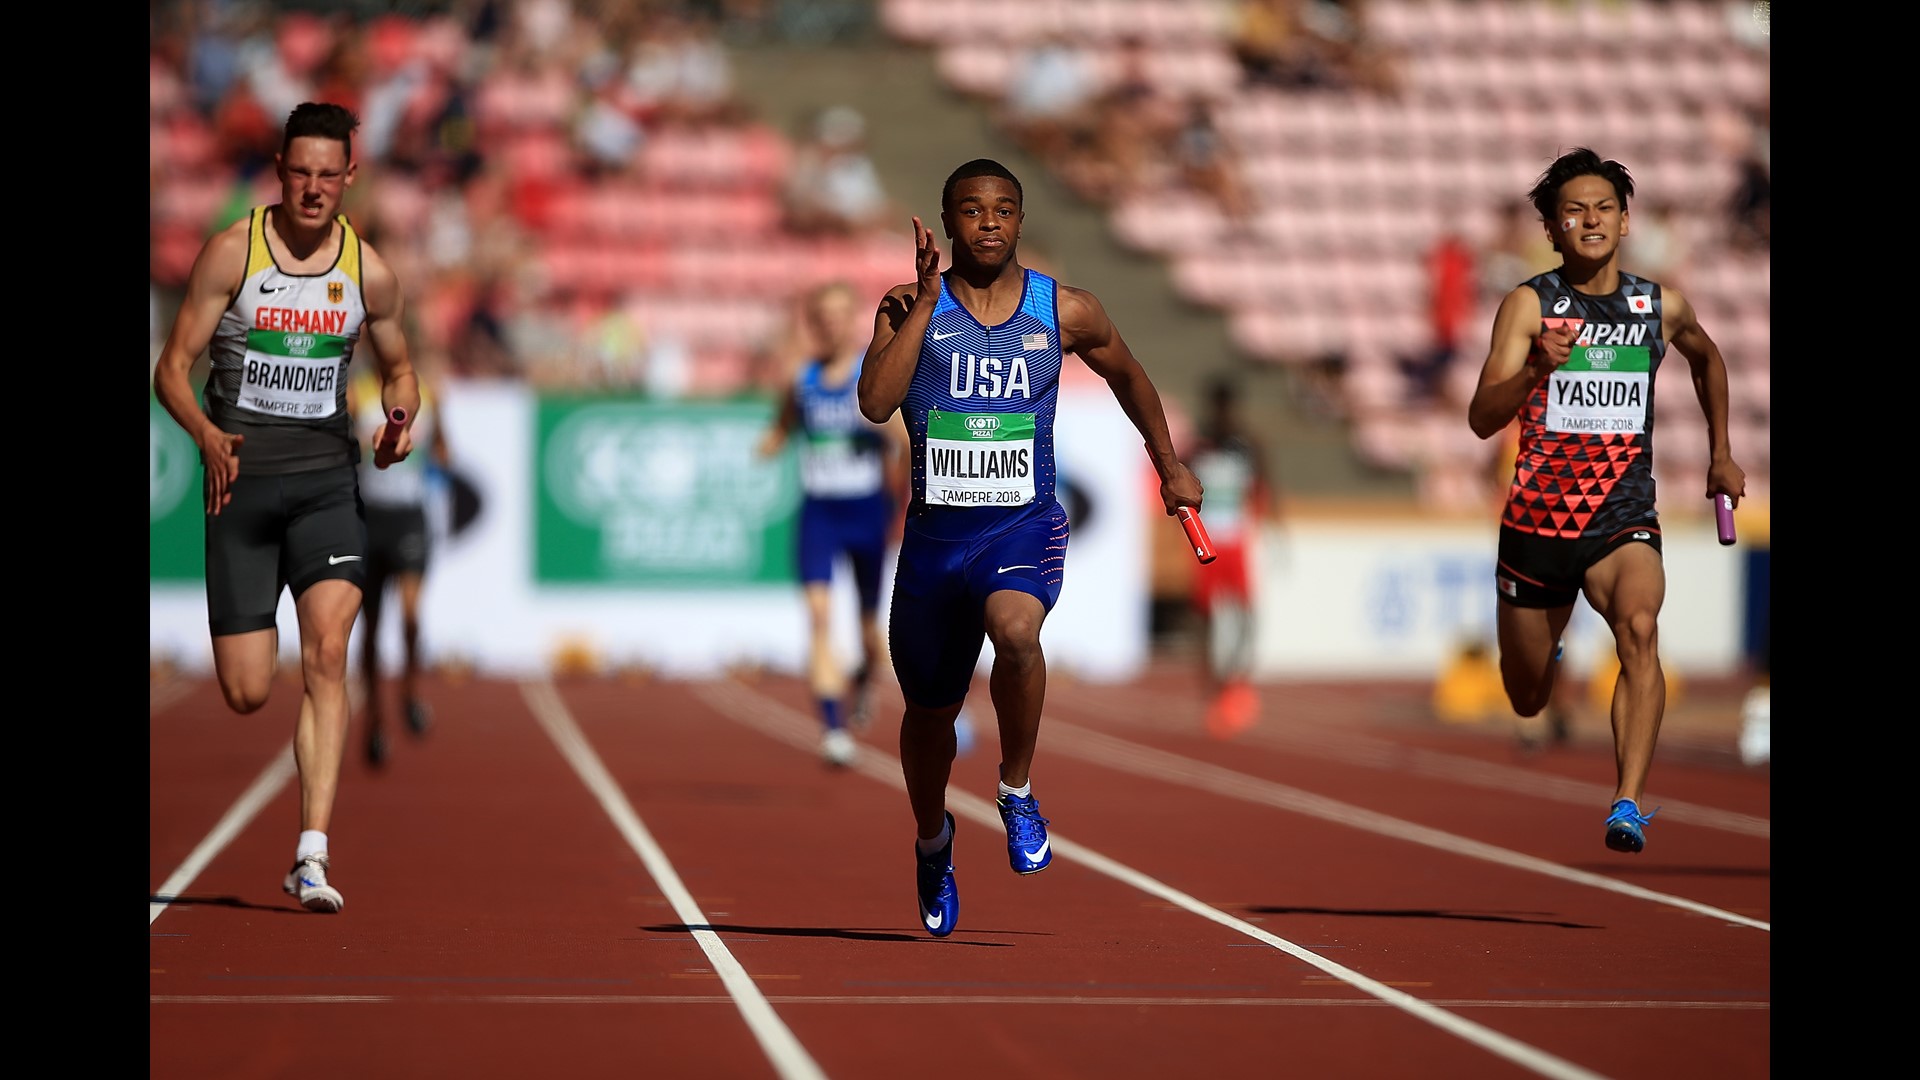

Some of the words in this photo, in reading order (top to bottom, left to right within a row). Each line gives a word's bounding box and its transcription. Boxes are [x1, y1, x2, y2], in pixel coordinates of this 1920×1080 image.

[255, 306, 347, 335] GERMANY
[247, 360, 335, 393] BRANDNER
[950, 352, 1030, 398] USA
[1556, 380, 1641, 407] YASUDA
[252, 397, 300, 414] TAMPERE
[302, 404, 323, 414] 2018
[968, 419, 996, 429] KOTI
[1561, 417, 1608, 430] TAMPERE
[1611, 419, 1634, 431] 2018
[931, 447, 1029, 479] WILLIAMS
[941, 490, 993, 503] TAMPERE
[996, 491, 1021, 503] 2018
[1197, 546, 1204, 557] 4
